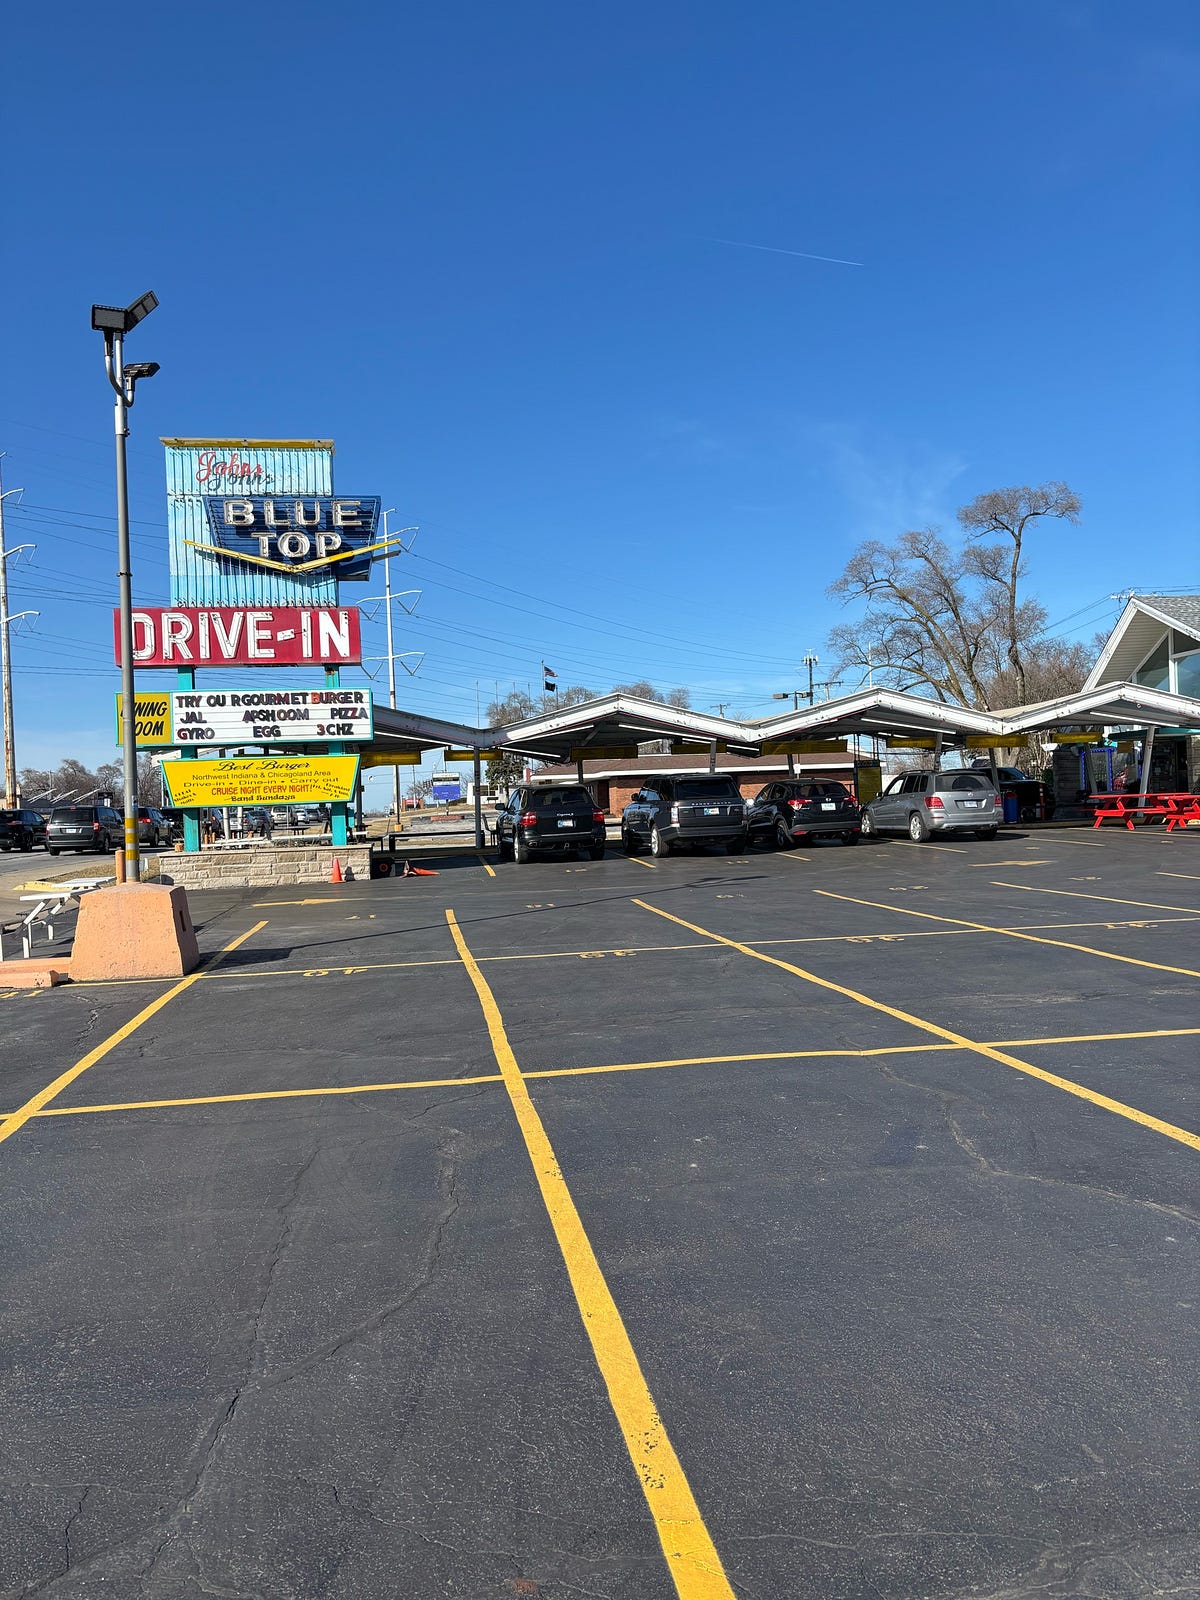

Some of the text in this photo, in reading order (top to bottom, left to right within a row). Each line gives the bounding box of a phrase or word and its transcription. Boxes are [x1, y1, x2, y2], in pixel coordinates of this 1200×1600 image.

[223, 500, 363, 526] BLUE
[251, 531, 342, 558] TOP
[131, 611, 350, 661] DRIVE-IN
[176, 694, 202, 708] TRY
[310, 691, 364, 705] BURGER
[180, 711, 207, 724] JAL
[330, 707, 369, 720] PIZZA
[177, 727, 216, 741] GYRO
[252, 725, 282, 738] EGG
[213, 759, 311, 772] Best Burger
[192, 772, 229, 781] Northwest
[231, 772, 258, 780] Indiana
[267, 770, 313, 779] Chicagoland
[290, 778, 321, 786] Carry
[211, 786, 239, 796] CRUISE
[240, 786, 261, 795] NIGHT
[263, 785, 287, 794] EVERY
[289, 784, 313, 793] NIGHT!
[231, 793, 296, 803] Band Sundays
